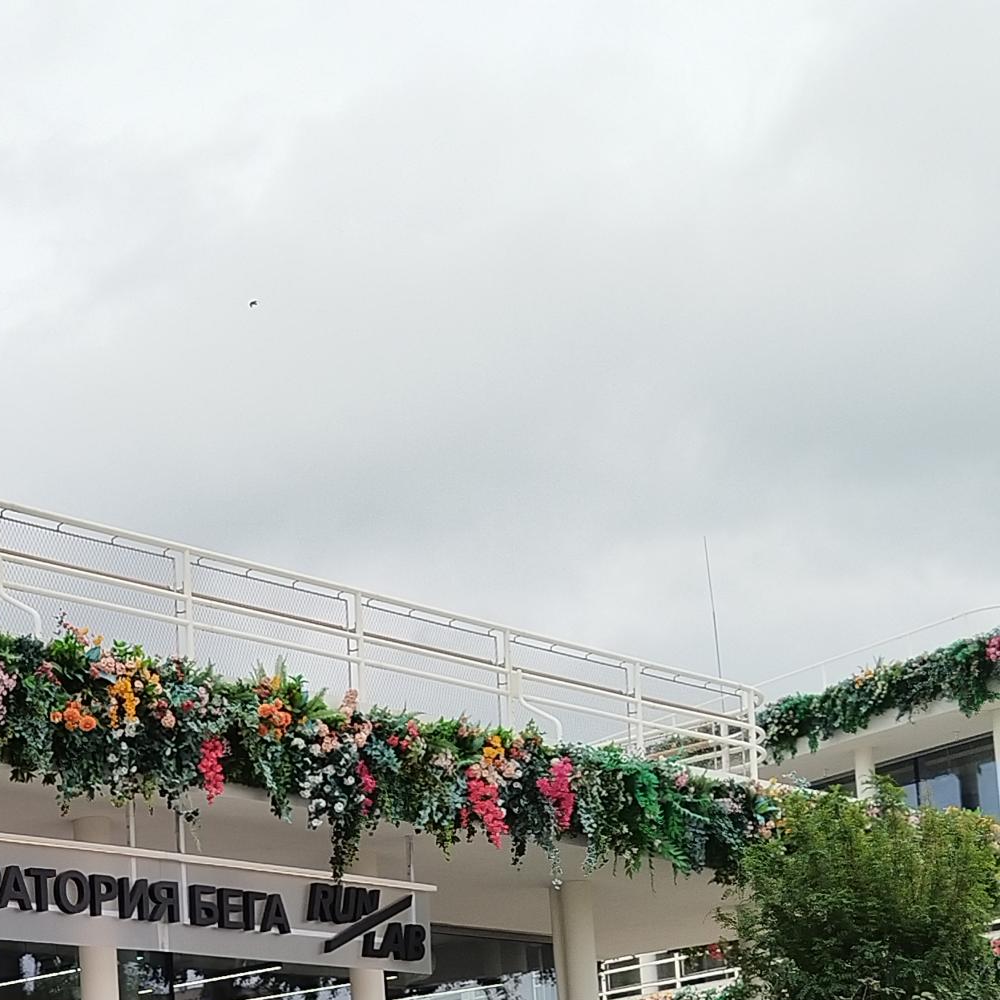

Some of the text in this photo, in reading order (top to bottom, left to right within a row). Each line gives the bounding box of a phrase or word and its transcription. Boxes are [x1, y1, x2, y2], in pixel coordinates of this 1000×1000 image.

[187, 884, 291, 934] БЕГА
[306, 881, 381, 926] RUN
[361, 922, 427, 961] LAB
